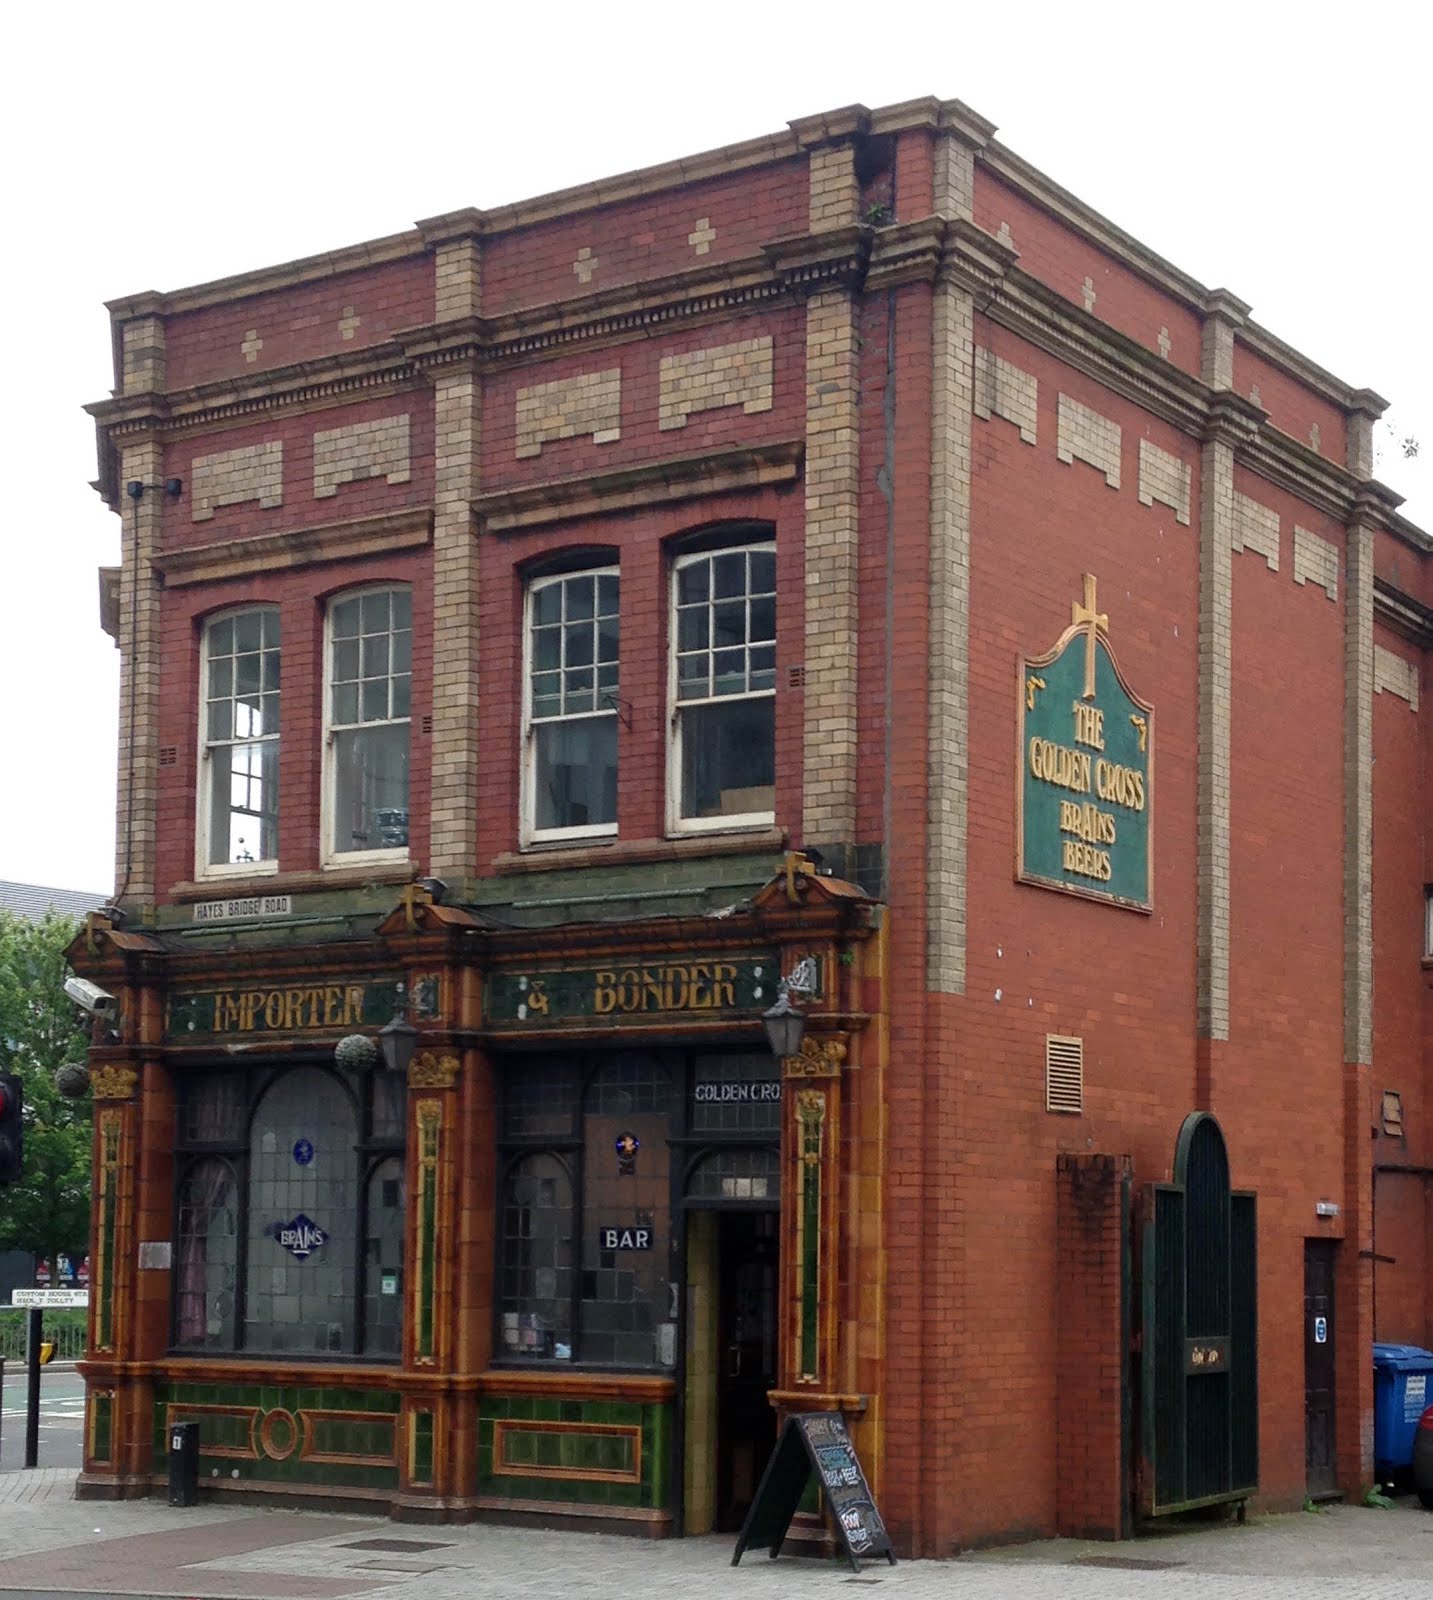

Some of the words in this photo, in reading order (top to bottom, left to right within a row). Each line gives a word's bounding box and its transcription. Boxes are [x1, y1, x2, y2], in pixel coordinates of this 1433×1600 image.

[1073, 701, 1104, 750] THE
[1030, 736, 1091, 793] GOLDEN
[1095, 758, 1144, 811] CROSS
[1060, 800, 1115, 844] BRAINS
[1062, 840, 1112, 881] BEERS
[197, 904, 223, 918] HAYES
[229, 900, 258, 916] BRIDGE
[265, 898, 287, 913] ROAD
[213, 986, 365, 1031] IMPORTER
[594, 965, 738, 1013] BONDER
[695, 1084, 748, 1100] GOLDEN
[751, 1084, 781, 1099] CRO
[606, 1230, 648, 1248] BAR
